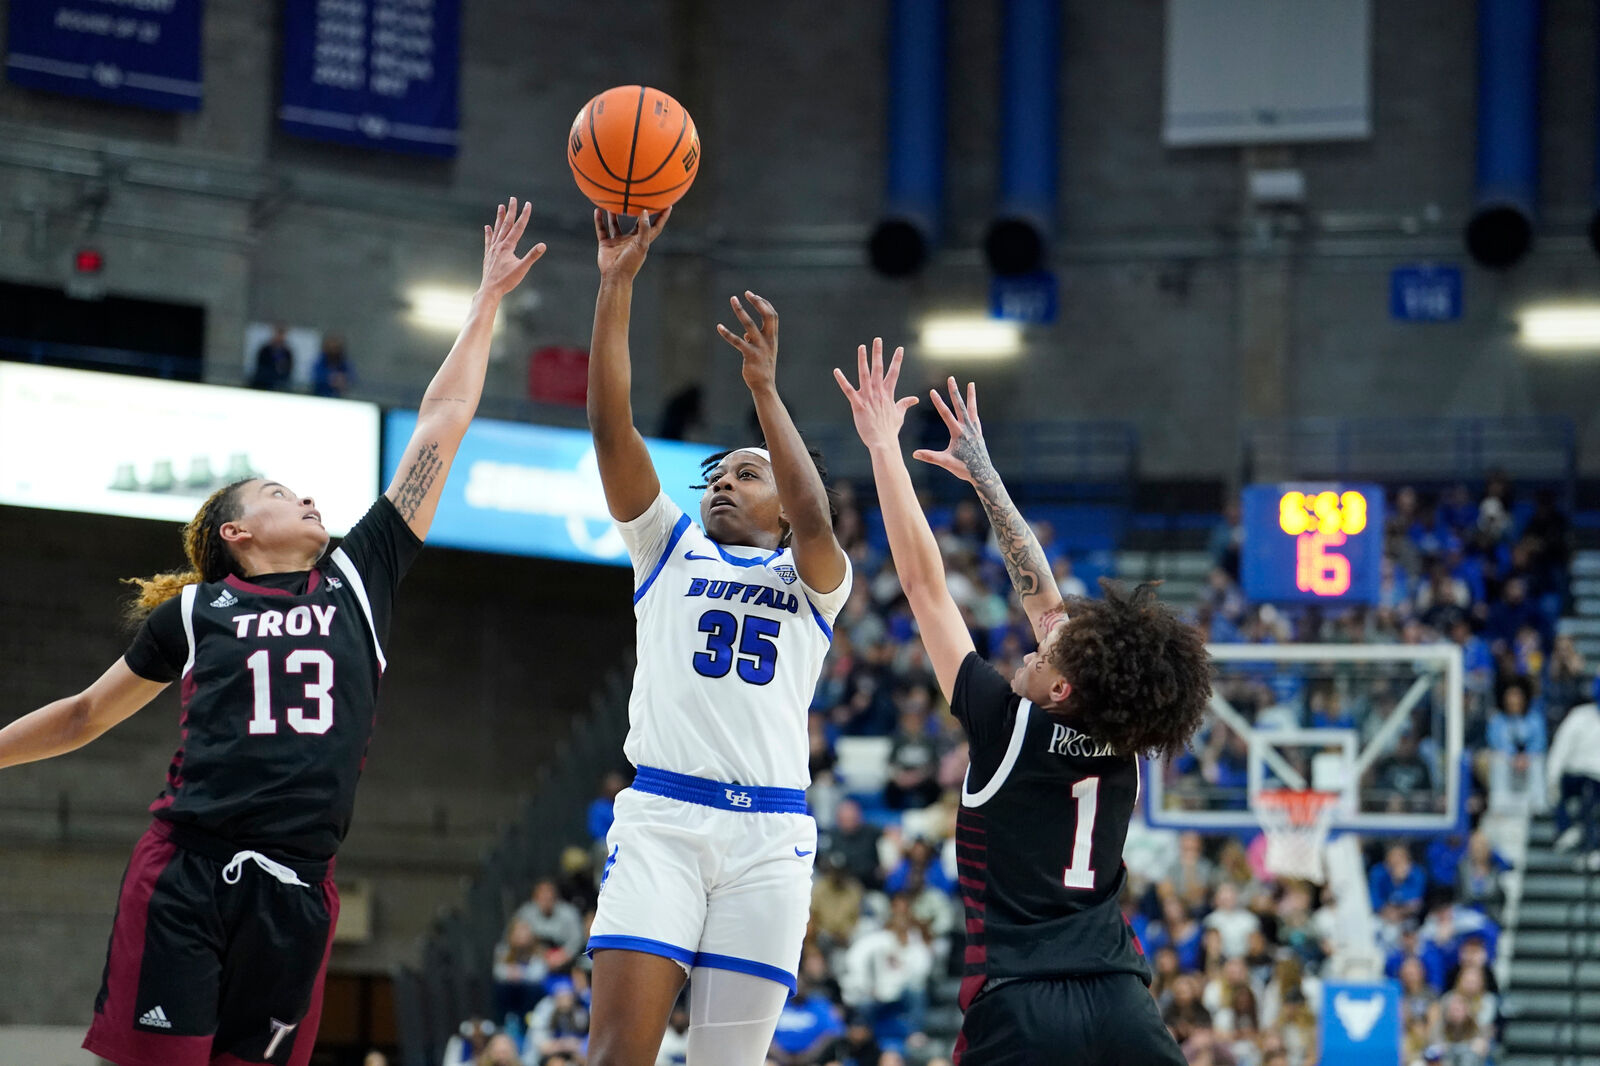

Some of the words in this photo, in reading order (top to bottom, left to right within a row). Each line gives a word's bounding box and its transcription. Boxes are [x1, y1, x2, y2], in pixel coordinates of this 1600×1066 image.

[1296, 531, 1351, 596] 16
[232, 604, 337, 638] TROY
[684, 577, 799, 614] BUFFALO
[692, 609, 781, 686] 35
[247, 649, 334, 735] 13
[724, 789, 752, 808] UB
[1063, 775, 1100, 890] 1
[139, 1017, 172, 1029] adidas
